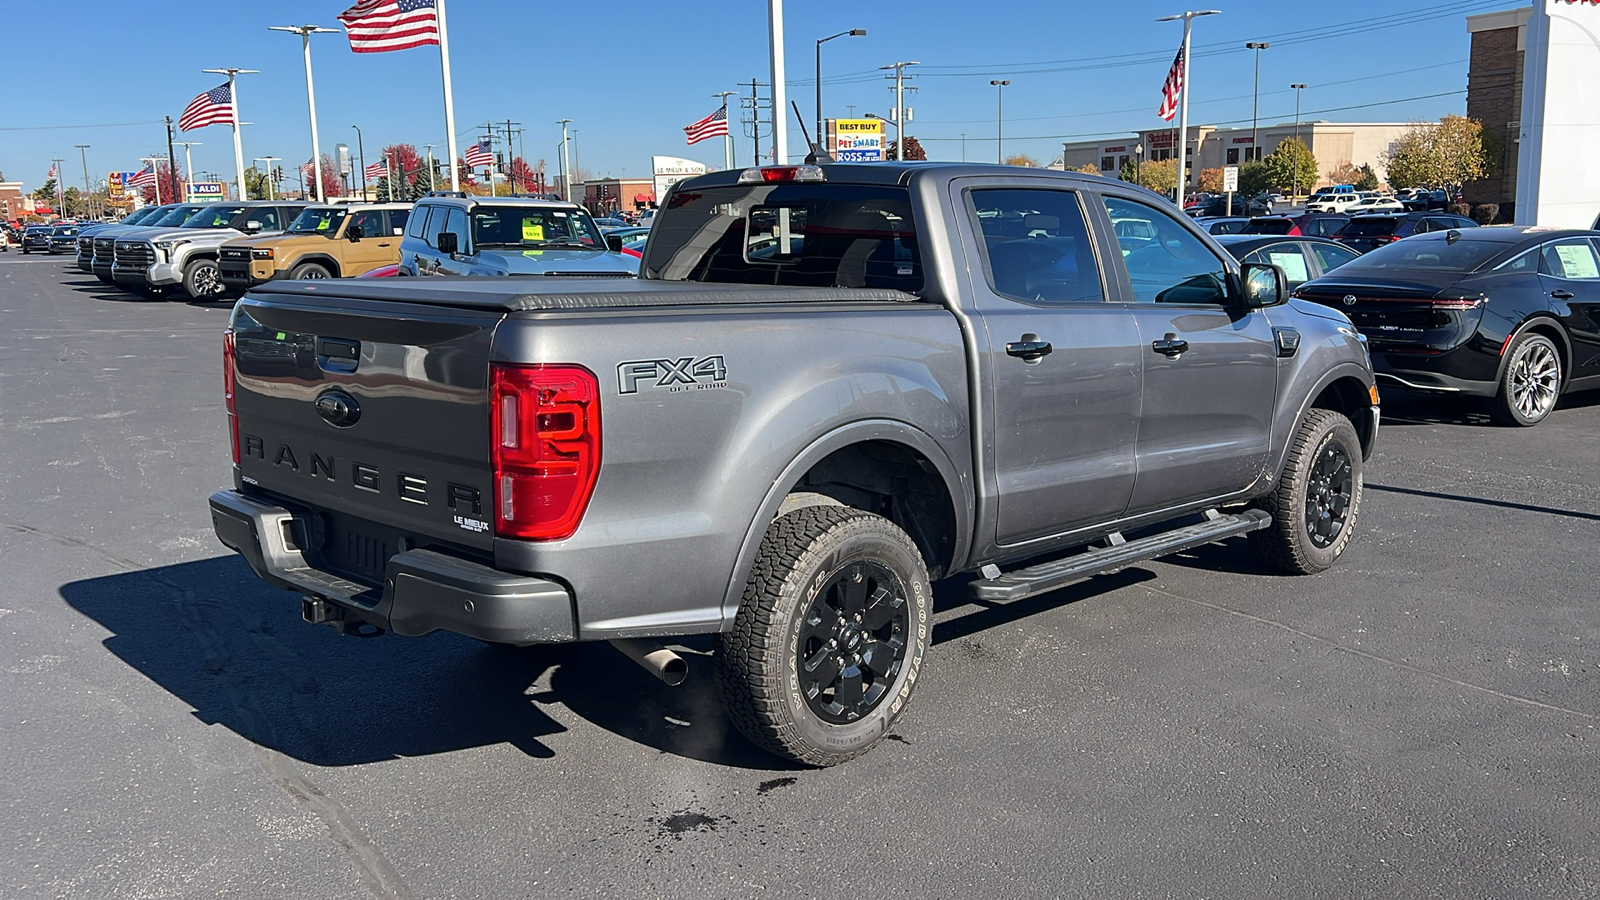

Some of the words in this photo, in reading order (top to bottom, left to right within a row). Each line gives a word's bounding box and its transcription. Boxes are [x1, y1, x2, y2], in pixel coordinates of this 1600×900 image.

[838, 152, 862, 161] ROSS
[615, 354, 728, 396] FX4
[697, 382, 728, 390] ROAD
[244, 433, 482, 517] RANGER
[454, 515, 464, 525] LE
[464, 517, 489, 531] MIEUX
[789, 570, 827, 711] WRANGLER
[890, 580, 926, 714] GOODYEAR
